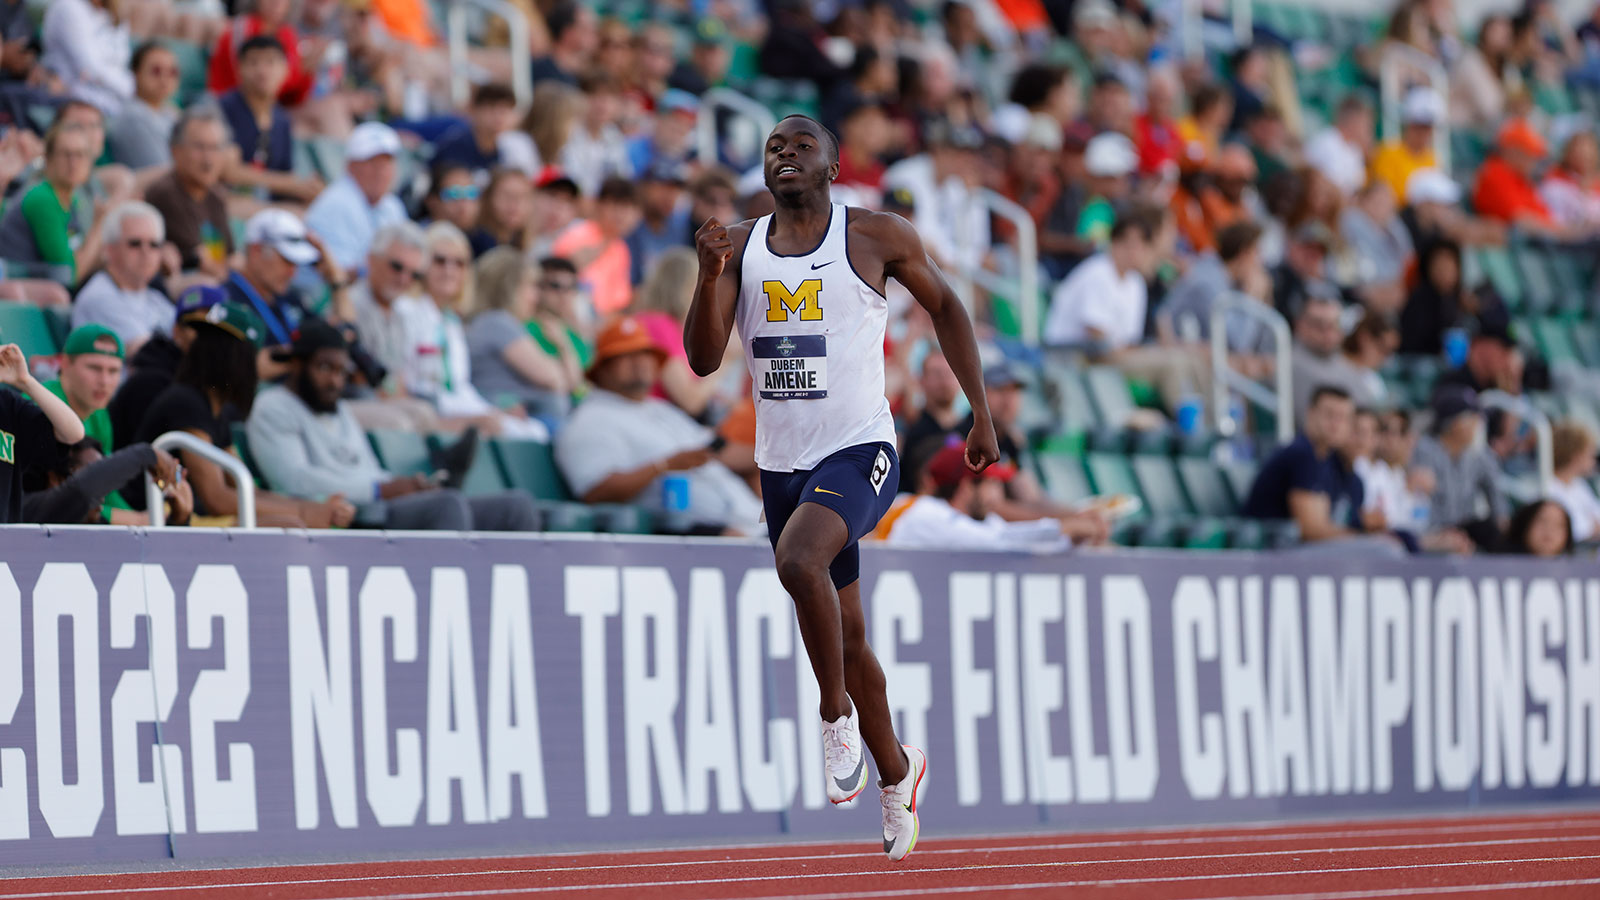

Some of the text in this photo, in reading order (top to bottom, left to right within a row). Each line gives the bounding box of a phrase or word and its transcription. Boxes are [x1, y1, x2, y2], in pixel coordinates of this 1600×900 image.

[762, 279, 823, 322] M
[764, 370, 817, 389] AMENE
[770, 359, 805, 371] DUBEM
[872, 453, 888, 486] 8
[287, 564, 548, 829] NCAA
[948, 571, 1159, 806] FIELD
[1171, 574, 1600, 800] CHAMPIONSH
